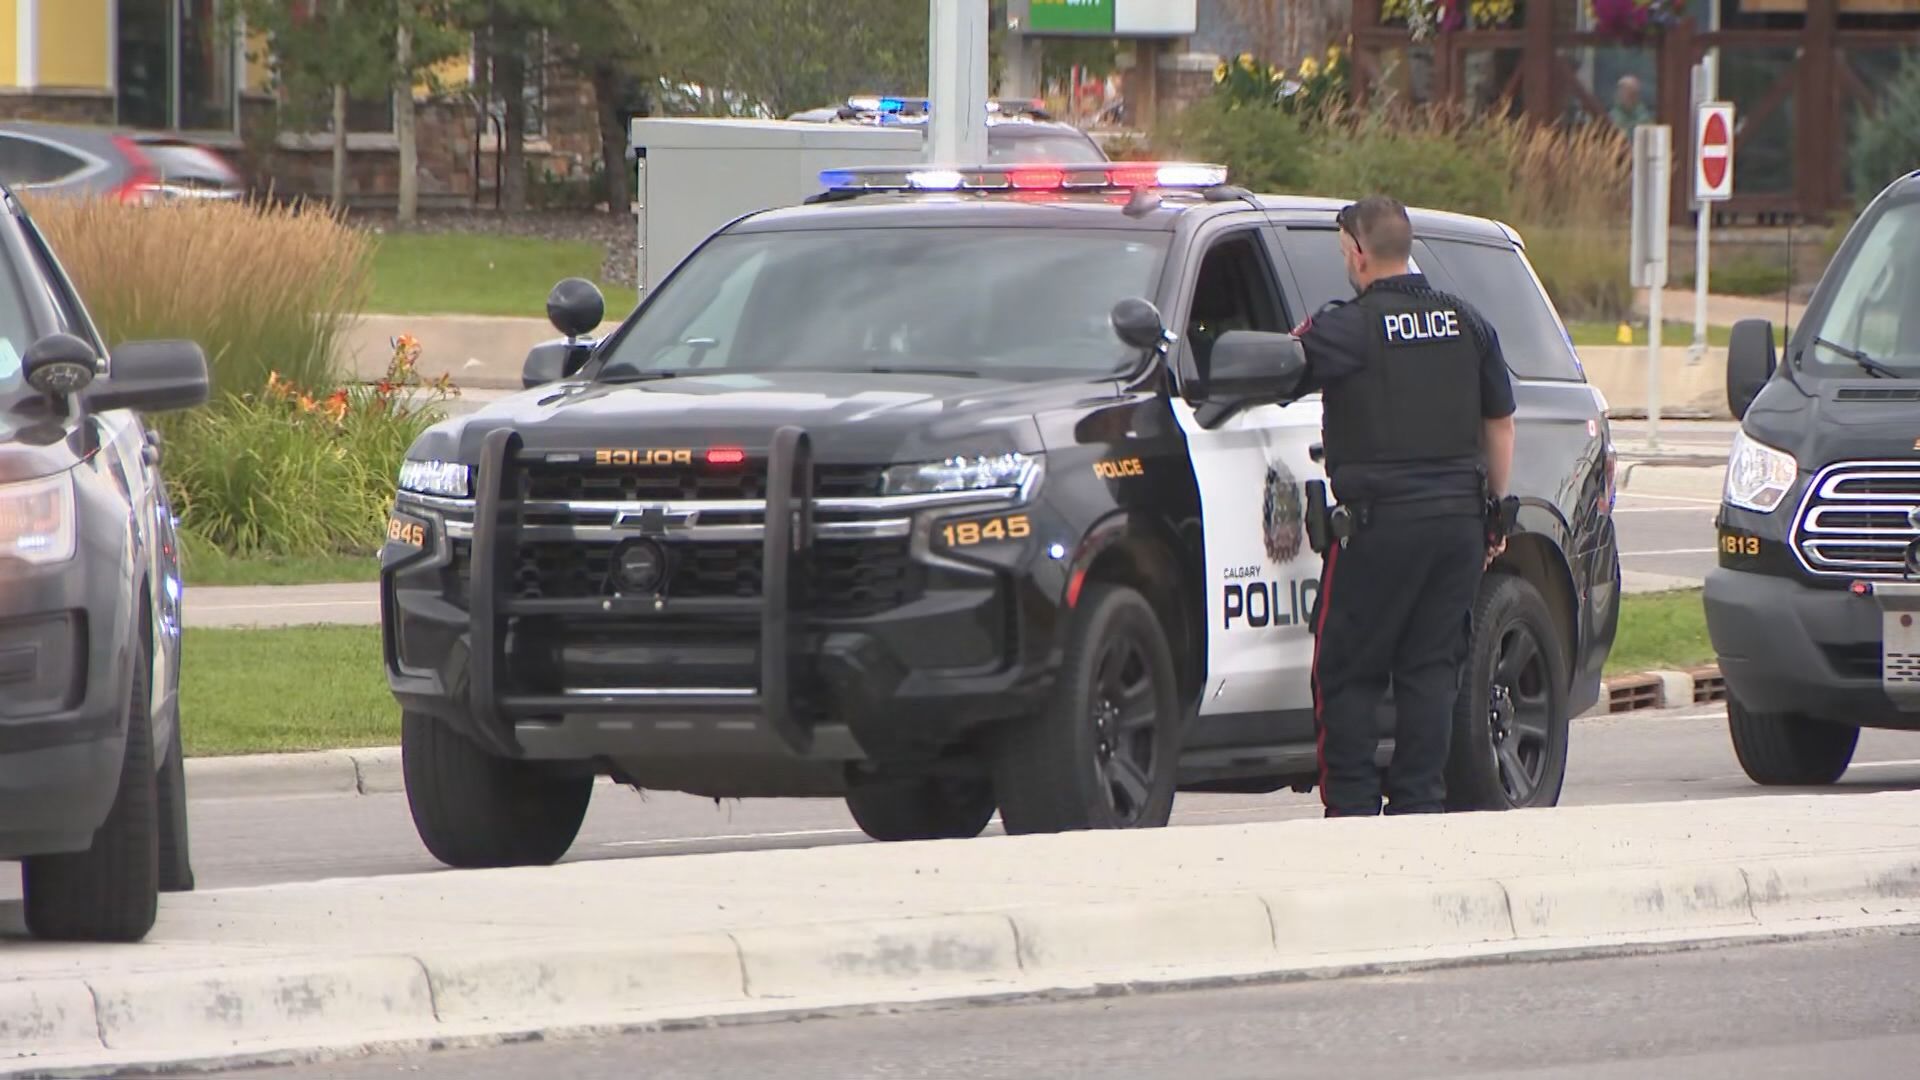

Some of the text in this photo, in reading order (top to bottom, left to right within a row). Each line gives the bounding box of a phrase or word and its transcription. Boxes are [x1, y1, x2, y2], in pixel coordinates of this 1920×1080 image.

[1385, 311, 1460, 341] POLICE
[1093, 458, 1144, 479] POLICE
[942, 515, 1030, 547] 1845
[1721, 536, 1759, 555] 1813
[1224, 565, 1261, 579] CALGARY
[1224, 578, 1320, 630] POLIC
